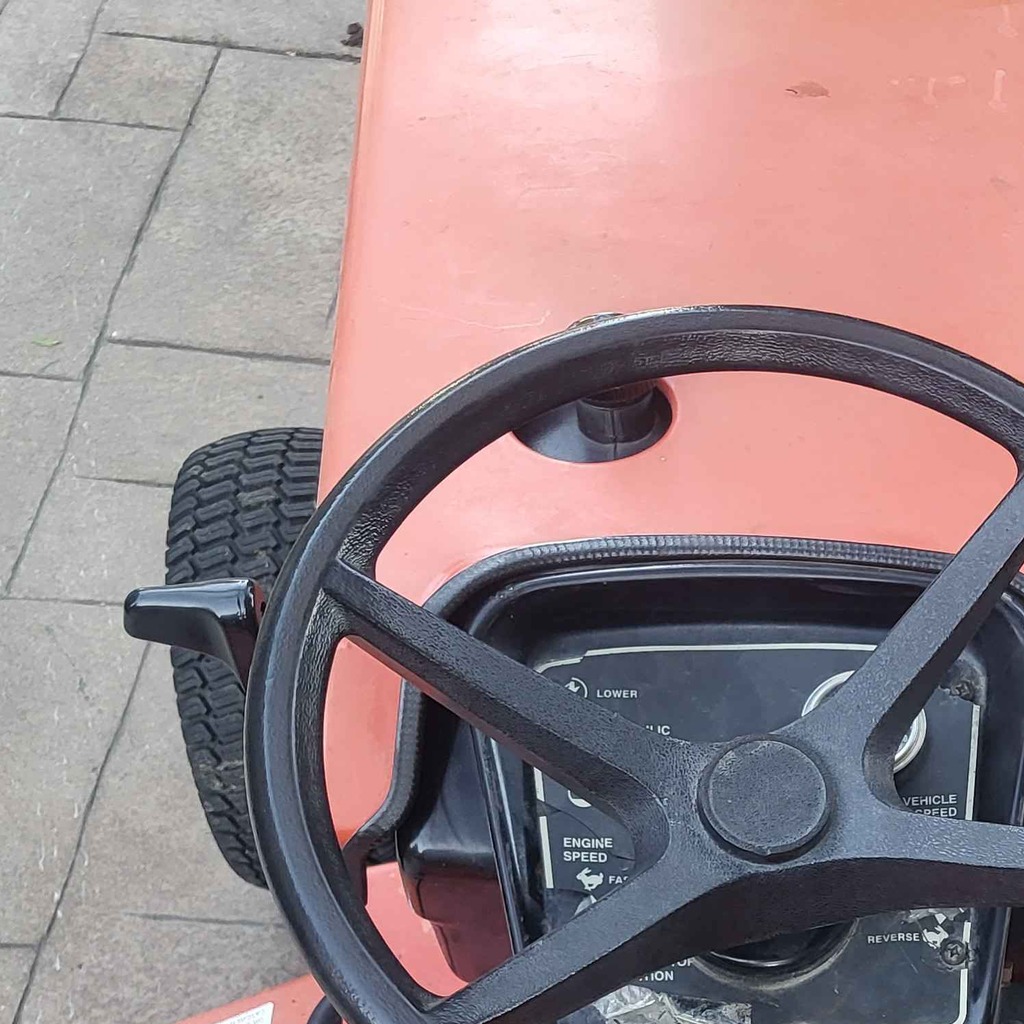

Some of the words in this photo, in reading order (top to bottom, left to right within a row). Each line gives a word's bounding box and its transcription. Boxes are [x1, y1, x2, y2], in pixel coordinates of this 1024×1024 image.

[596, 689, 638, 699] LOWER
[902, 794, 958, 806] VEHICLE
[563, 837, 614, 848] ENGINE
[563, 851, 608, 863] SPEED
[868, 932, 920, 944] REVERSE
